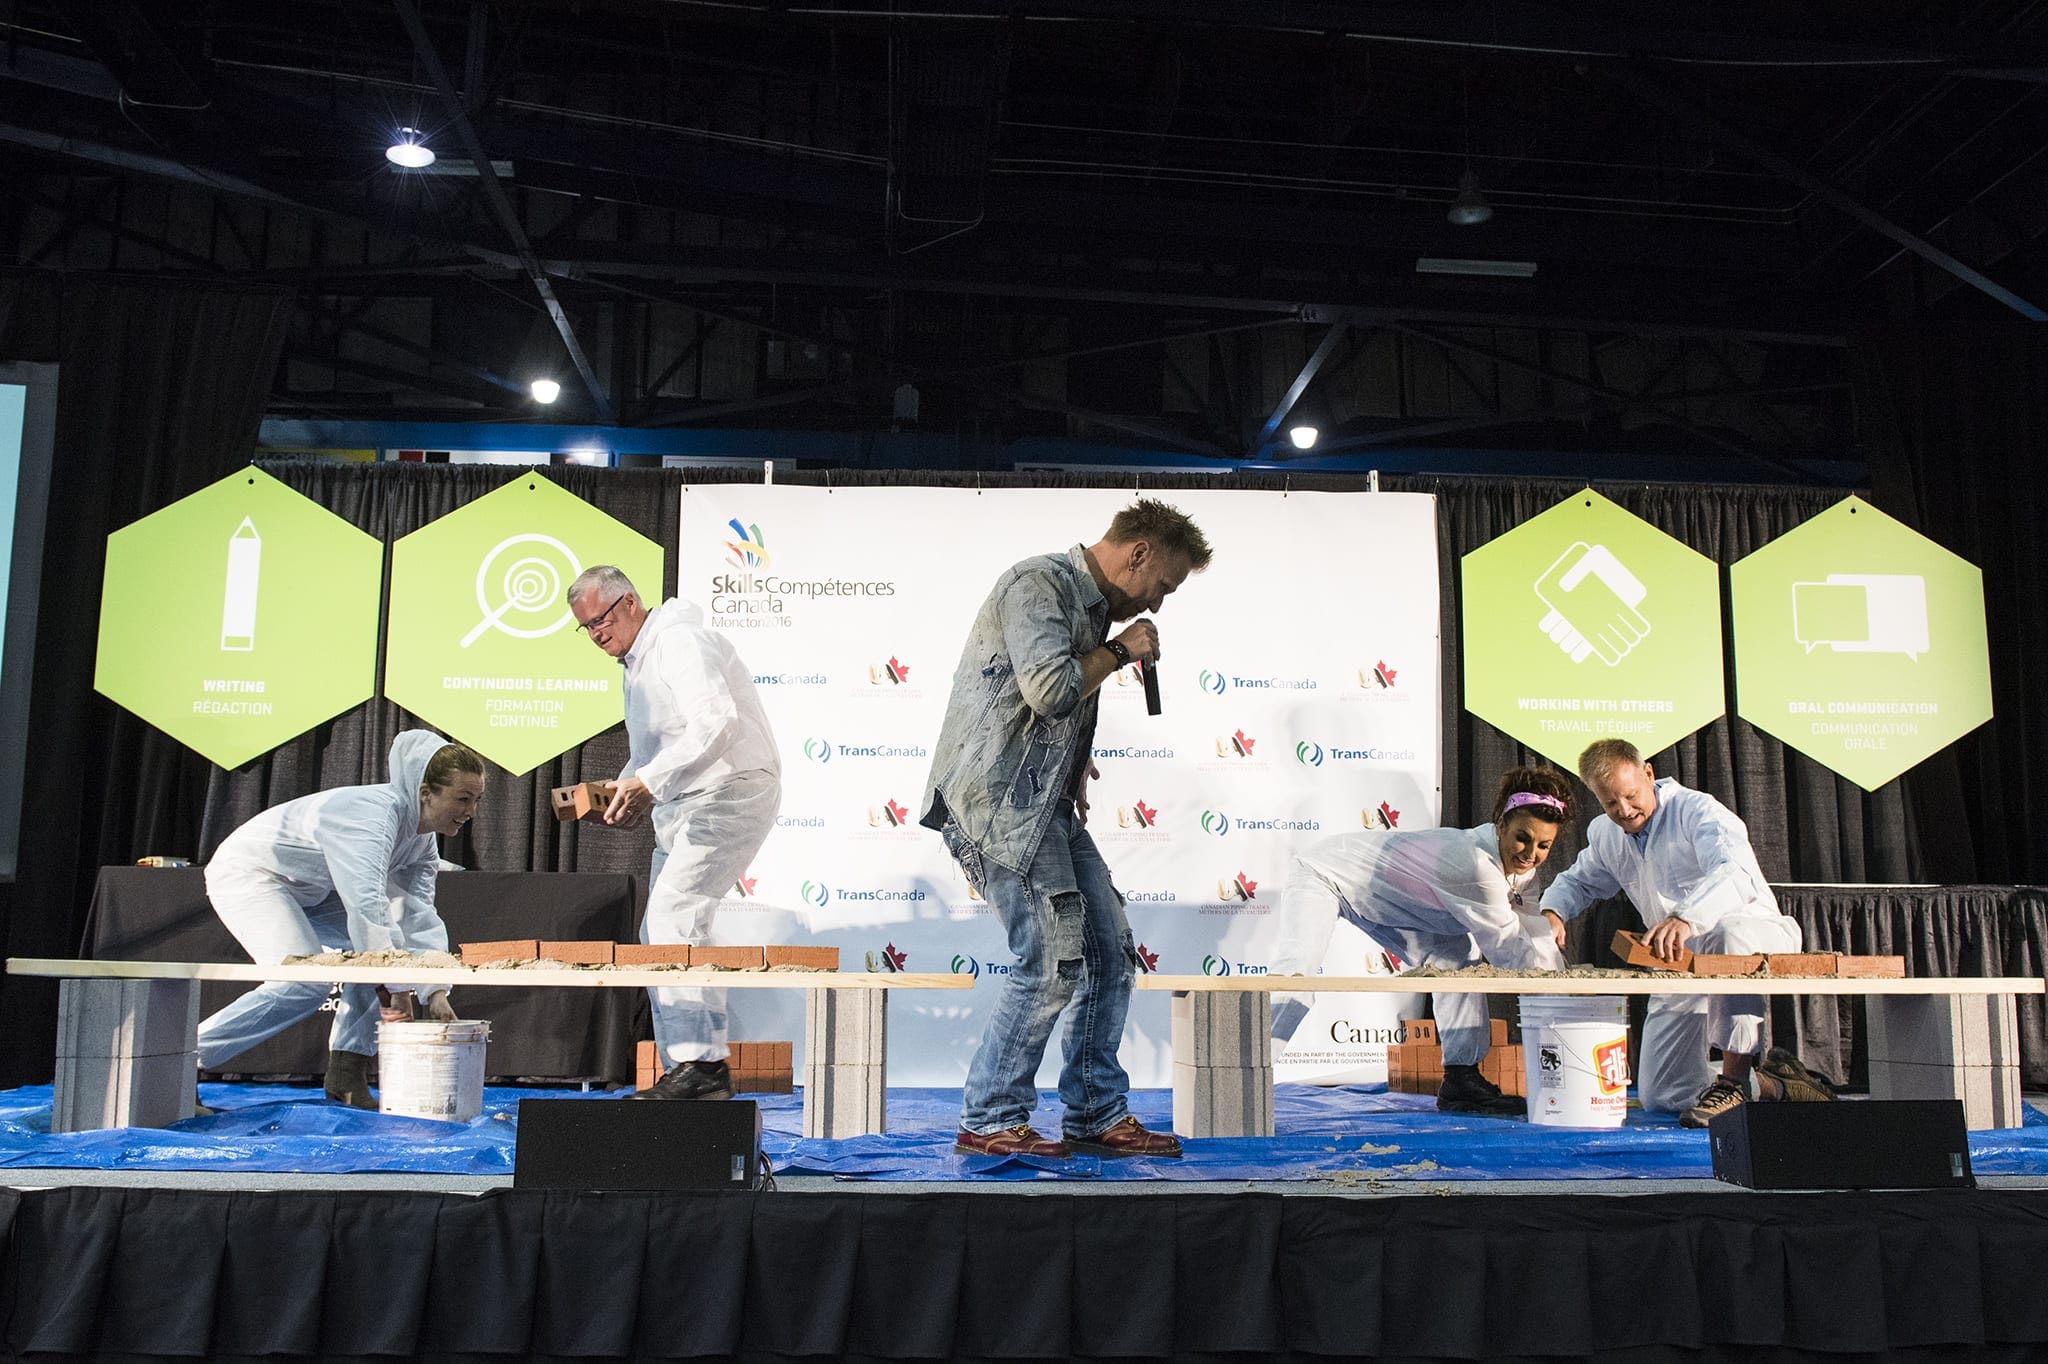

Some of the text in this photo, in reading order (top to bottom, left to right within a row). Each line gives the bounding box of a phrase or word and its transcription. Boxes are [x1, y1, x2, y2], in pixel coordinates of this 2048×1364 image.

[711, 594, 783, 614] Canada
[442, 676, 609, 692] CONTINUOUS LEARNING
[753, 673, 828, 685] ansCanada
[1232, 677, 1317, 690] TransCanada
[203, 679, 266, 694] WRITING
[192, 699, 273, 715] RÉDACTION
[485, 699, 565, 713] FORMATION
[1517, 697, 1674, 713] WORKING WITH OTHERS
[1788, 701, 1938, 715] ORAL COMMUNICATION
[489, 714, 559, 729] CONTINUE
[1539, 717, 1653, 735] TRAVAIL D'ÉQUIPE
[1810, 722, 1919, 736] COMMUNICATION
[1843, 737, 1888, 751] ORALE
[837, 745, 927, 759] TransCanada
[1092, 746, 1175, 759] ransCanada
[1330, 748, 1415, 761] TransCanada
[775, 815, 825, 828] Canada
[1235, 818, 1320, 831] TransCanada
[836, 888, 926, 902] TransCanada
[1330, 1020, 1406, 1045] Canad
